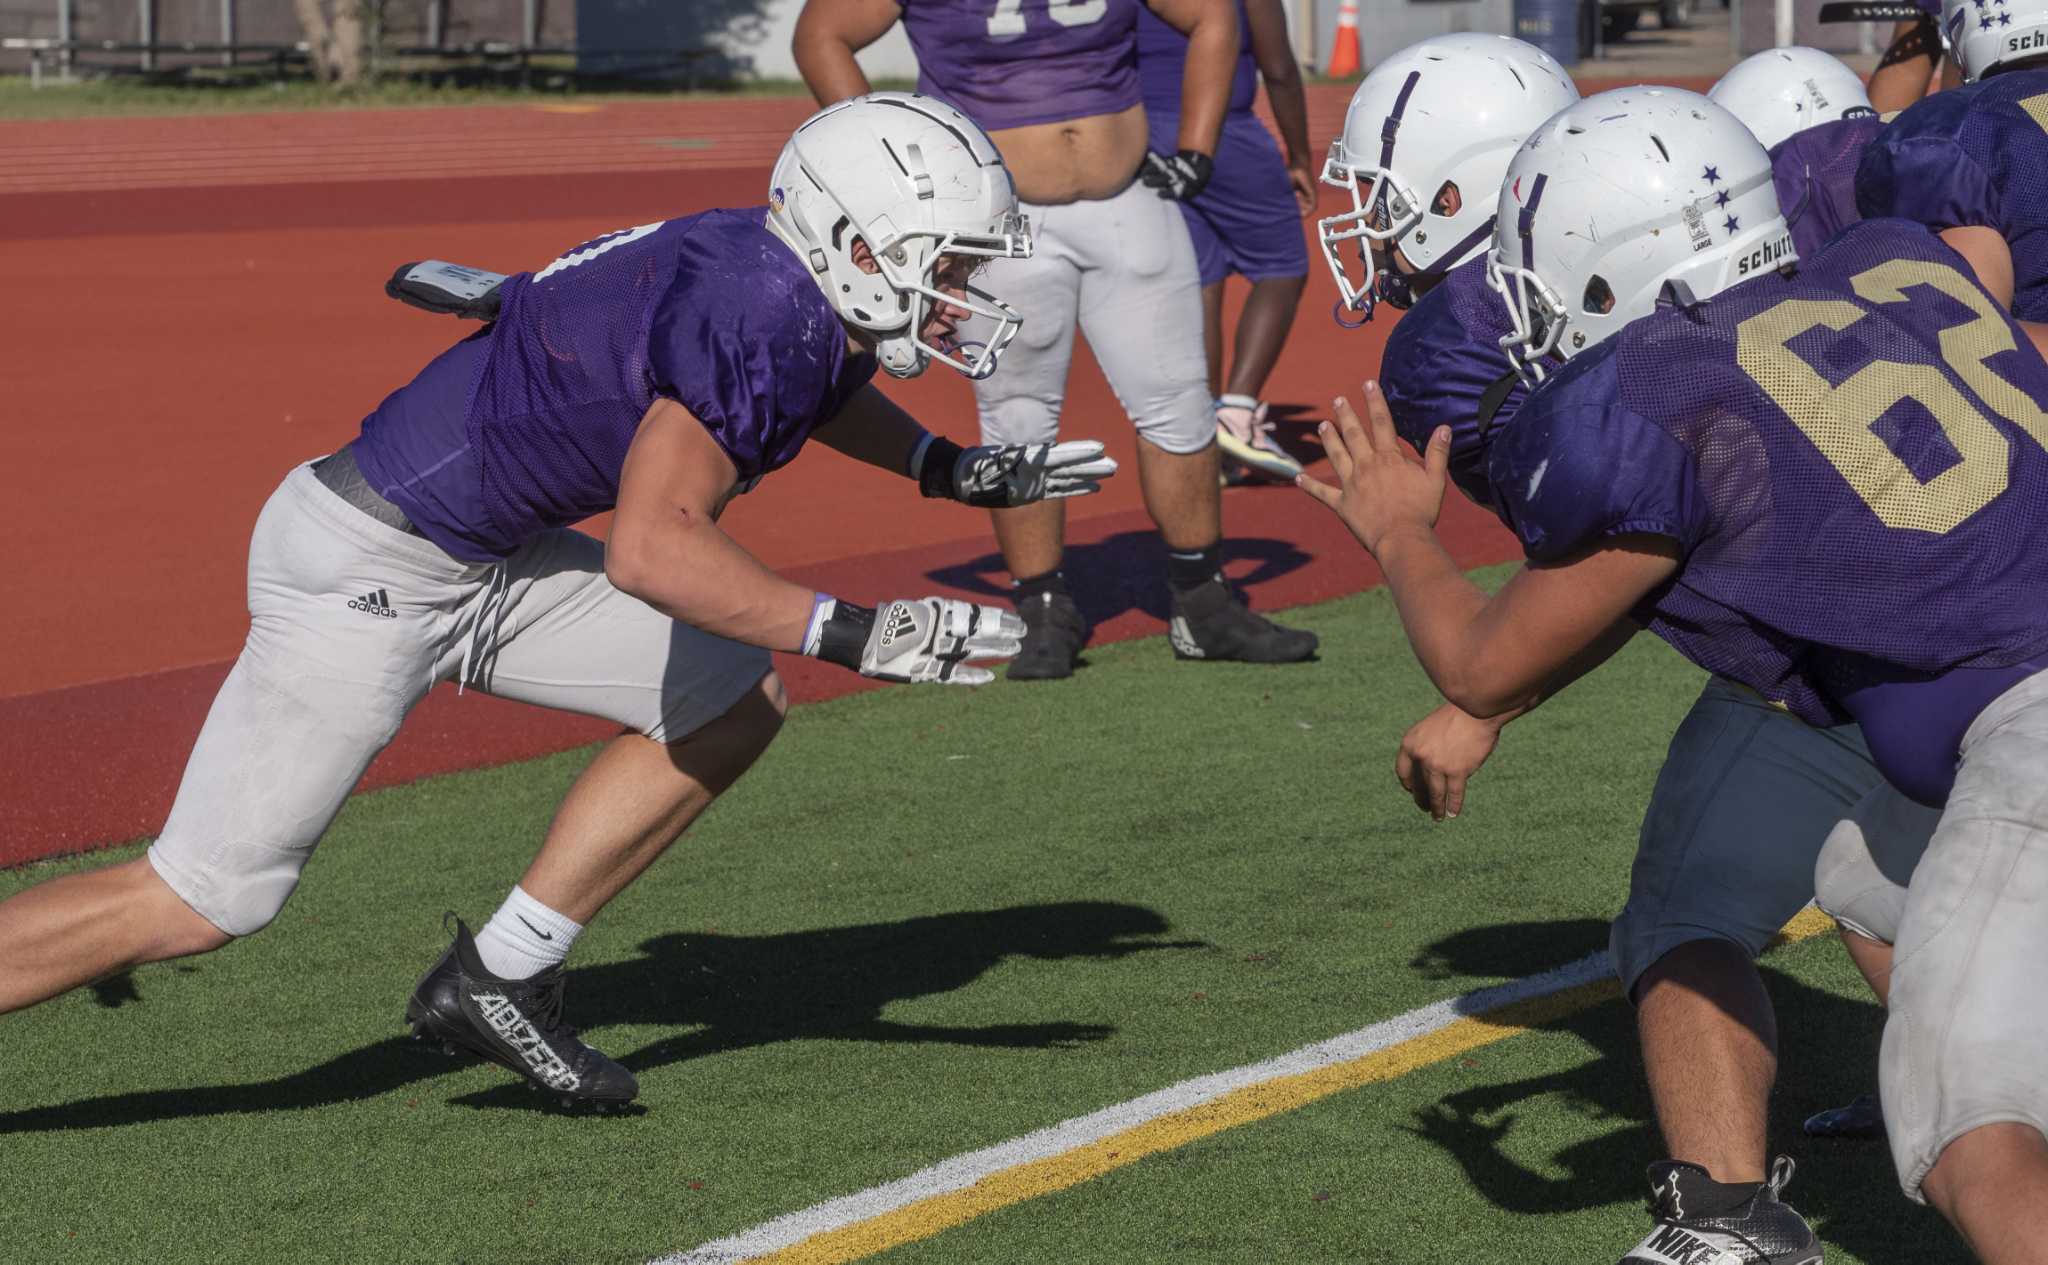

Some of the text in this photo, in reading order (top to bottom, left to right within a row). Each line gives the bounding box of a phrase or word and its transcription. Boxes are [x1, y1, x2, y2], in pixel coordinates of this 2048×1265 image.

[2009, 29, 2048, 52] sch
[1693, 238, 1713, 252] LARGE
[1737, 258, 2048, 534] 62
[347, 599, 398, 618] adidas
[881, 602, 903, 646] adidas
